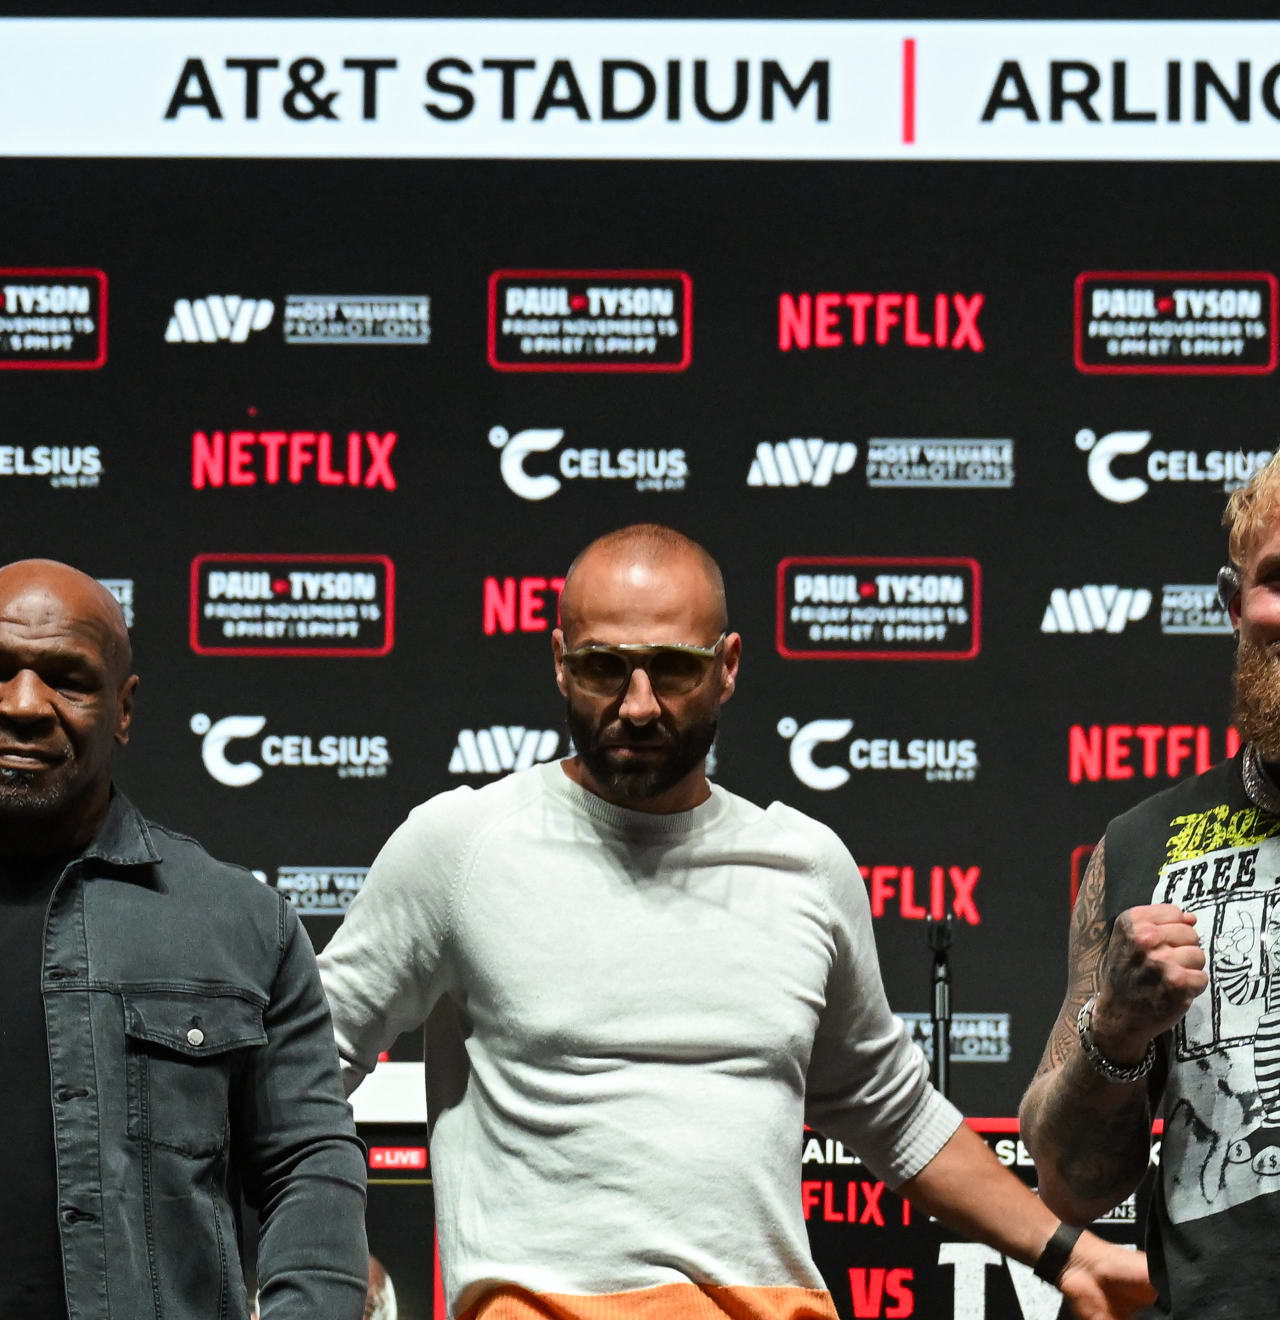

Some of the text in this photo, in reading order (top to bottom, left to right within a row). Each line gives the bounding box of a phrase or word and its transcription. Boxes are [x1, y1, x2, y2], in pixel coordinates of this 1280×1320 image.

[165, 57, 829, 122] AT&T STADIUM
[4, 286, 89, 313] TYSON
[506, 288, 673, 316] PAUL TYSON
[1093, 290, 1260, 318] PAUL TYSON
[780, 294, 983, 349] NETFLIX
[194, 433, 395, 488] NETFLIX
[559, 448, 687, 478] CELSIUS
[209, 572, 375, 599] PAUL TYSON
[795, 576, 963, 603] PAUL TYSON
[262, 735, 390, 766] CELSIUS
[849, 739, 977, 769] CELSIUS
[1164, 848, 1260, 903] FREE
[385, 1150, 420, 1165] LIVE
[802, 1180, 885, 1226] FLIX
[848, 1268, 915, 1319] VS
